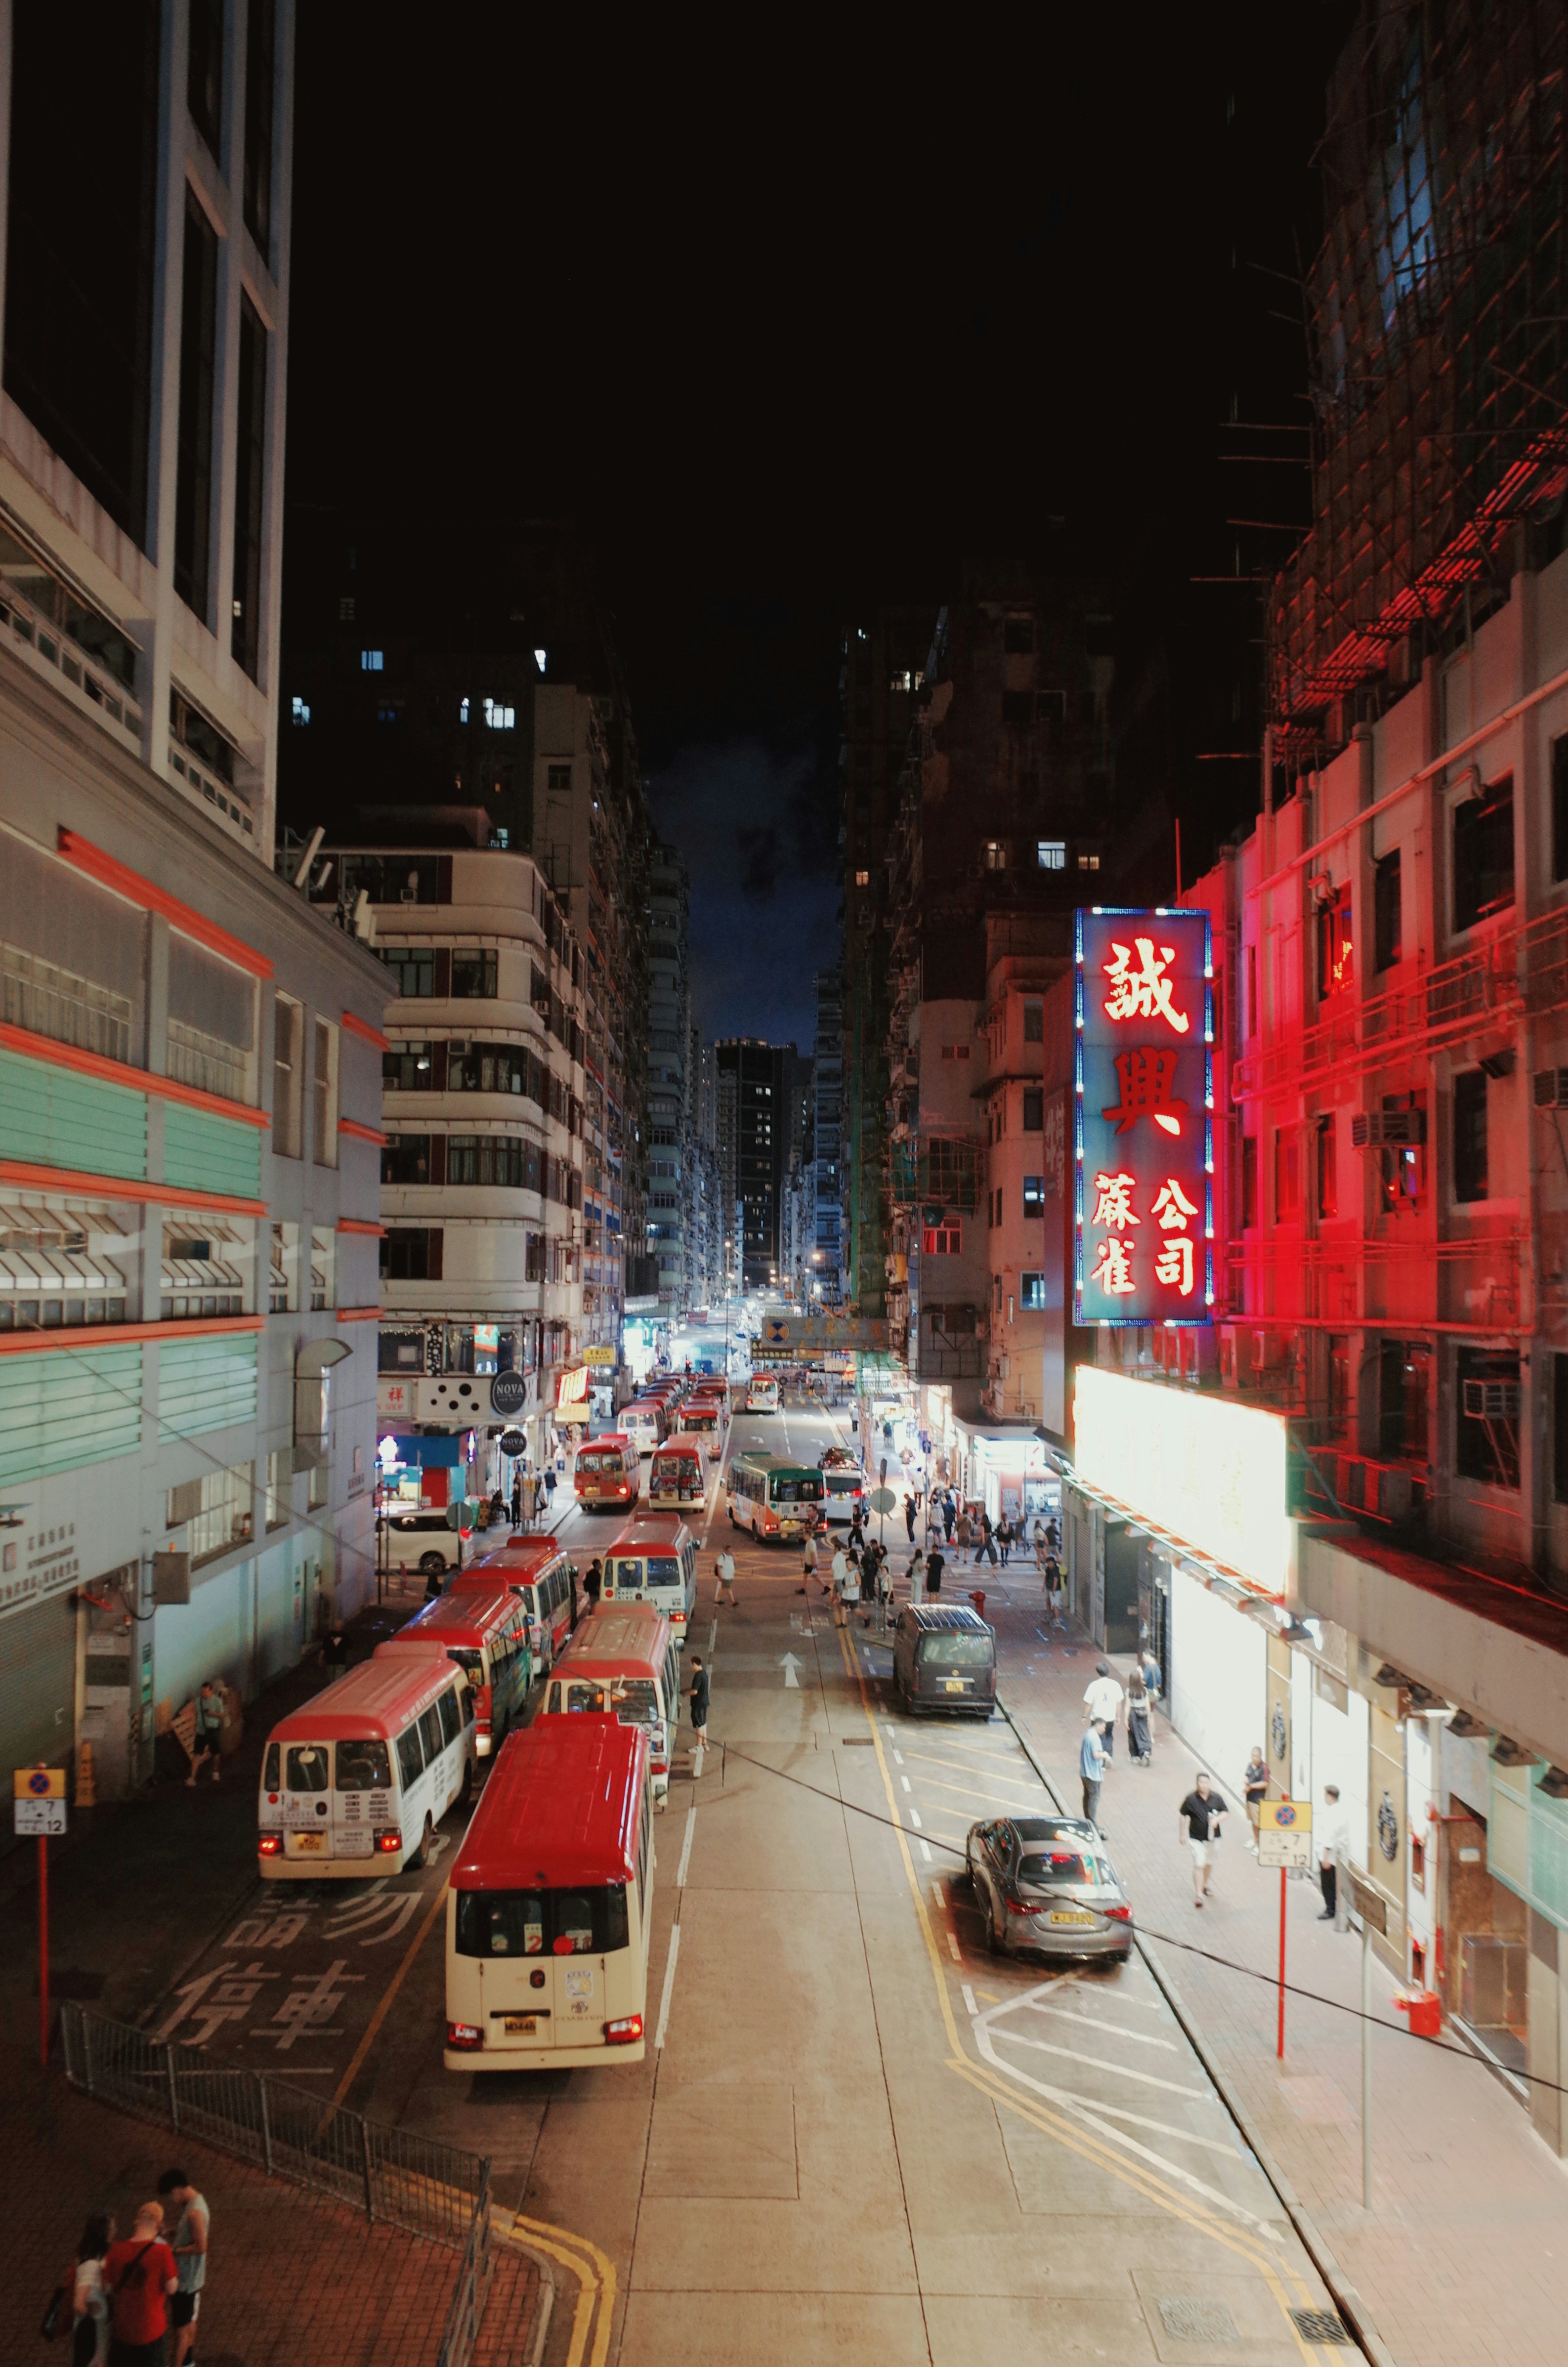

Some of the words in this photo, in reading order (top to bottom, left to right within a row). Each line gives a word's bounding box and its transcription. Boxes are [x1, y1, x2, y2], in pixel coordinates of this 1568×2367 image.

[1102, 937, 1189, 1136] 誠興
[1151, 1179, 1198, 1296] 公司
[496, 1384, 524, 1395] NOVA
[46, 1801, 54, 1812] 7
[47, 1820, 62, 1831] 12
[1292, 1833, 1300, 1846] 7
[1293, 1854, 1307, 1865] 12
[528, 1935, 542, 1953] 2
